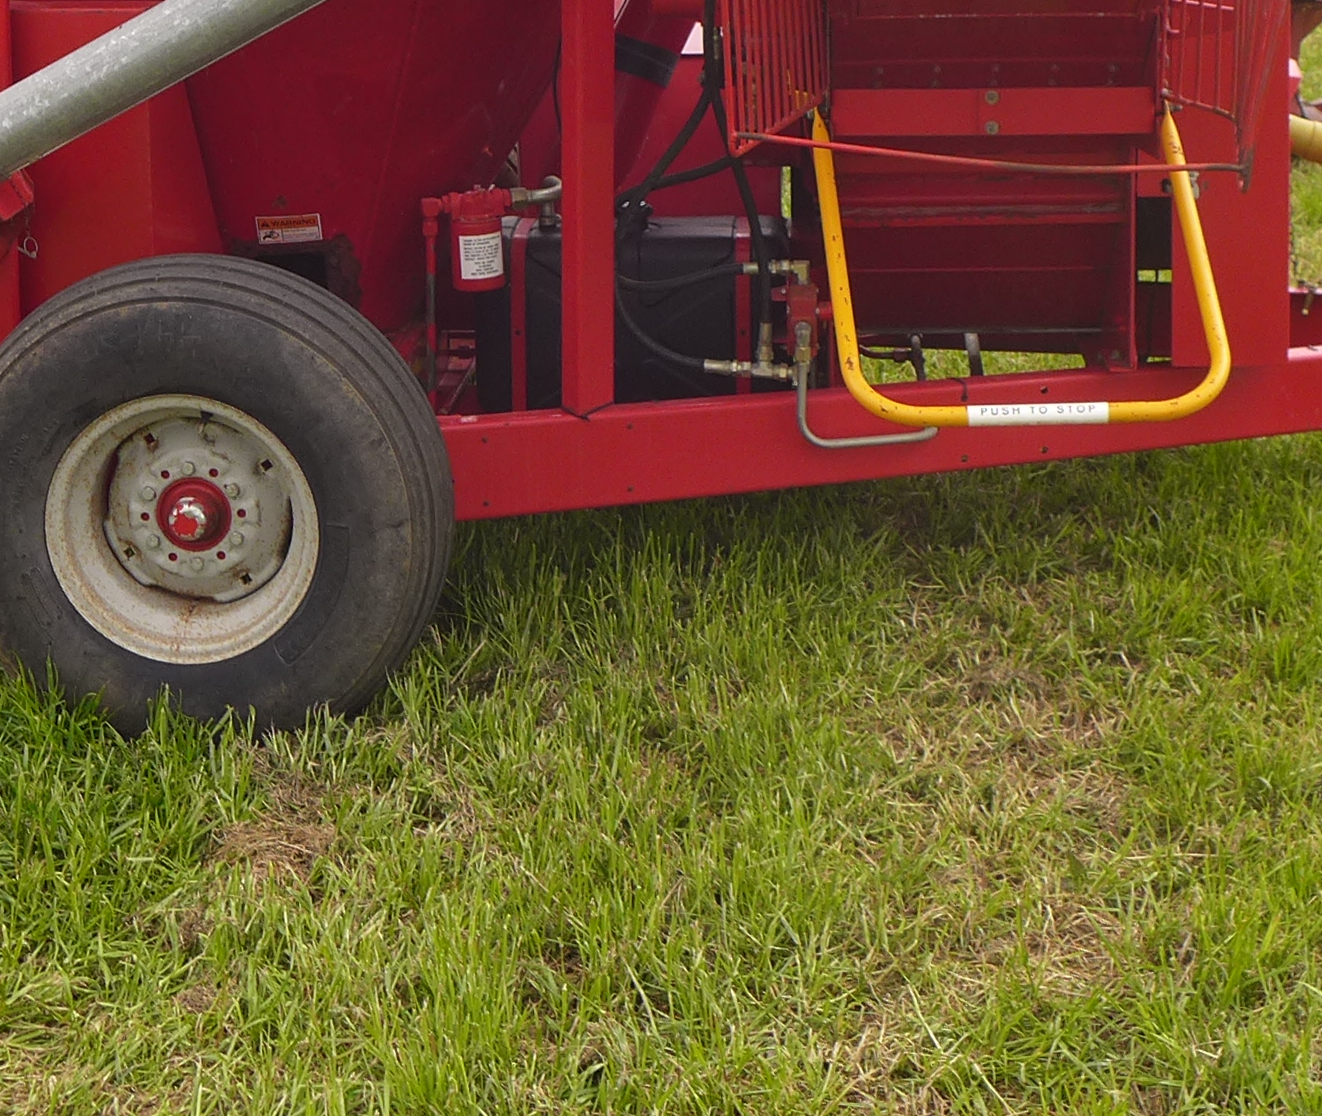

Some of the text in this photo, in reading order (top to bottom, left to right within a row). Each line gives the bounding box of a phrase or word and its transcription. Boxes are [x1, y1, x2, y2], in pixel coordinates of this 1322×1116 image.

[980, 404, 1096, 416] PUSH TO STOP
